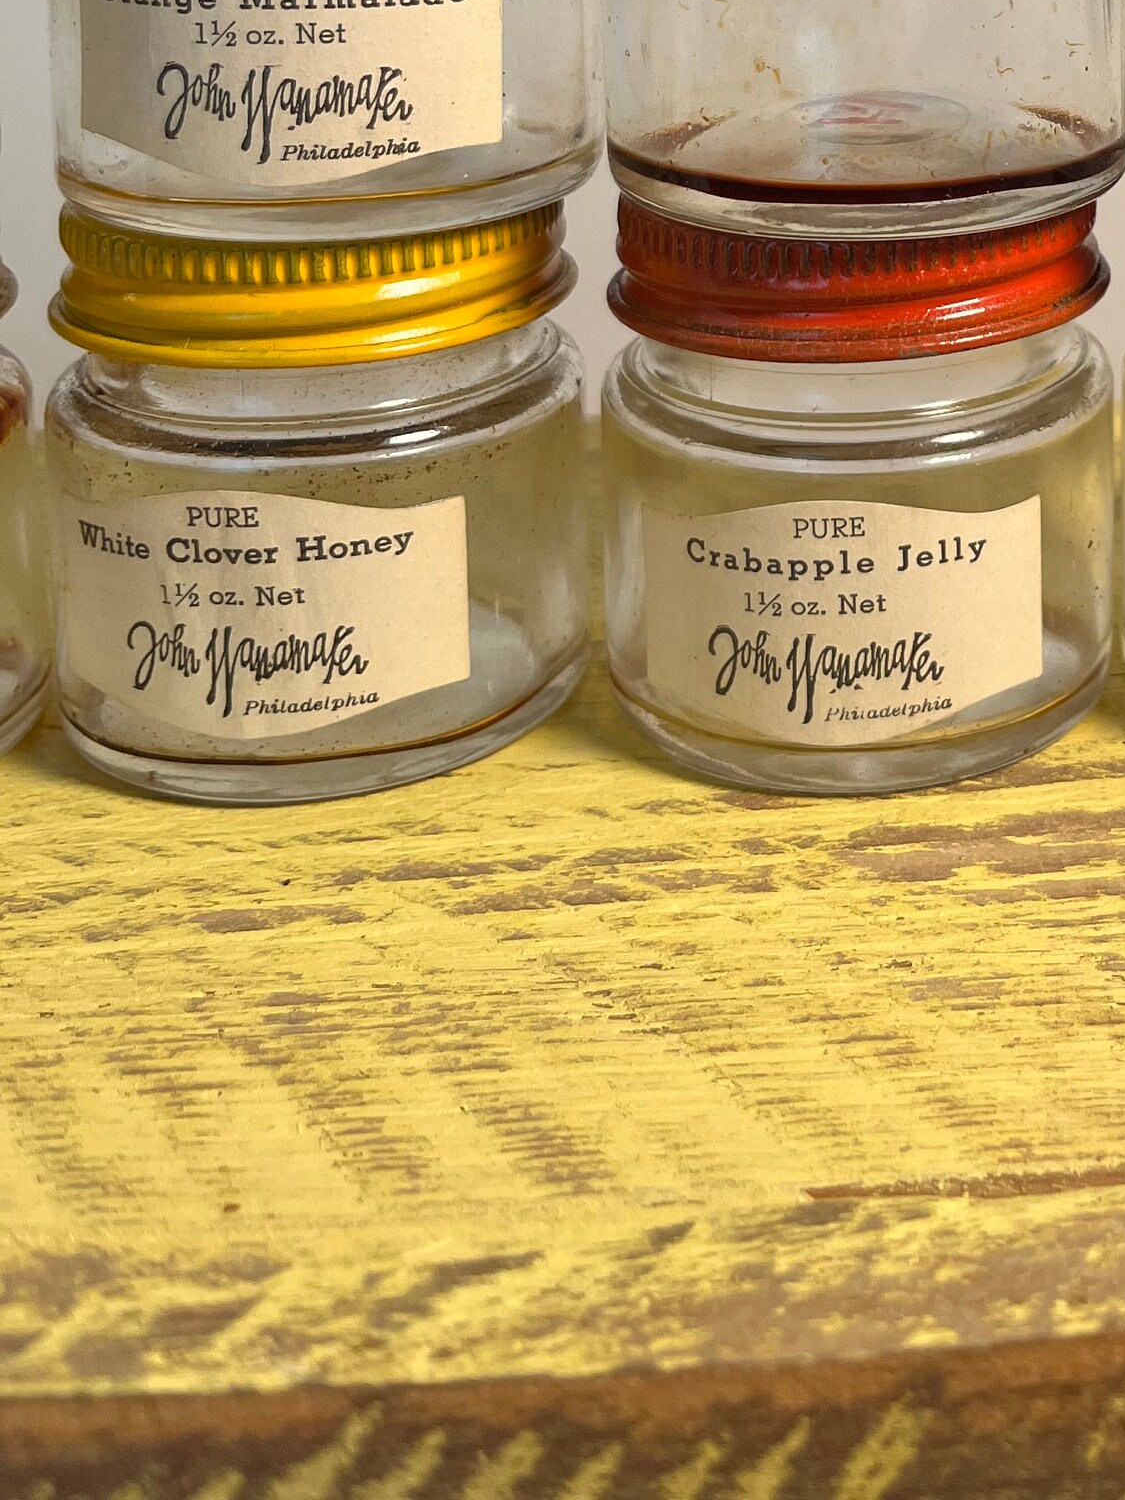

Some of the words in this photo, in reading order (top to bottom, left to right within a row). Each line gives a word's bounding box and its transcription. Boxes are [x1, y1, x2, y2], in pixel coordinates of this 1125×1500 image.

[245, 28, 284, 45] oz.
[296, 22, 346, 45] Net
[156, 61, 235, 140] John
[280, 138, 420, 161] Philadelphia
[186, 506, 259, 528] PURE
[793, 516, 865, 539] PURE
[79, 519, 151, 559] White
[166, 536, 278, 564] Clover
[296, 531, 414, 562] Honey
[686, 537, 875, 581] Crabapple
[897, 536, 987, 572] Jelly
[209, 591, 244, 606] oz.
[256, 586, 305, 606] Net
[791, 601, 826, 615] oz.
[838, 594, 886, 614] Net
[127, 620, 200, 690] John
[709, 624, 781, 695] John
[243, 690, 380, 716] Philadelphia
[824, 695, 953, 722] Philadelphia
